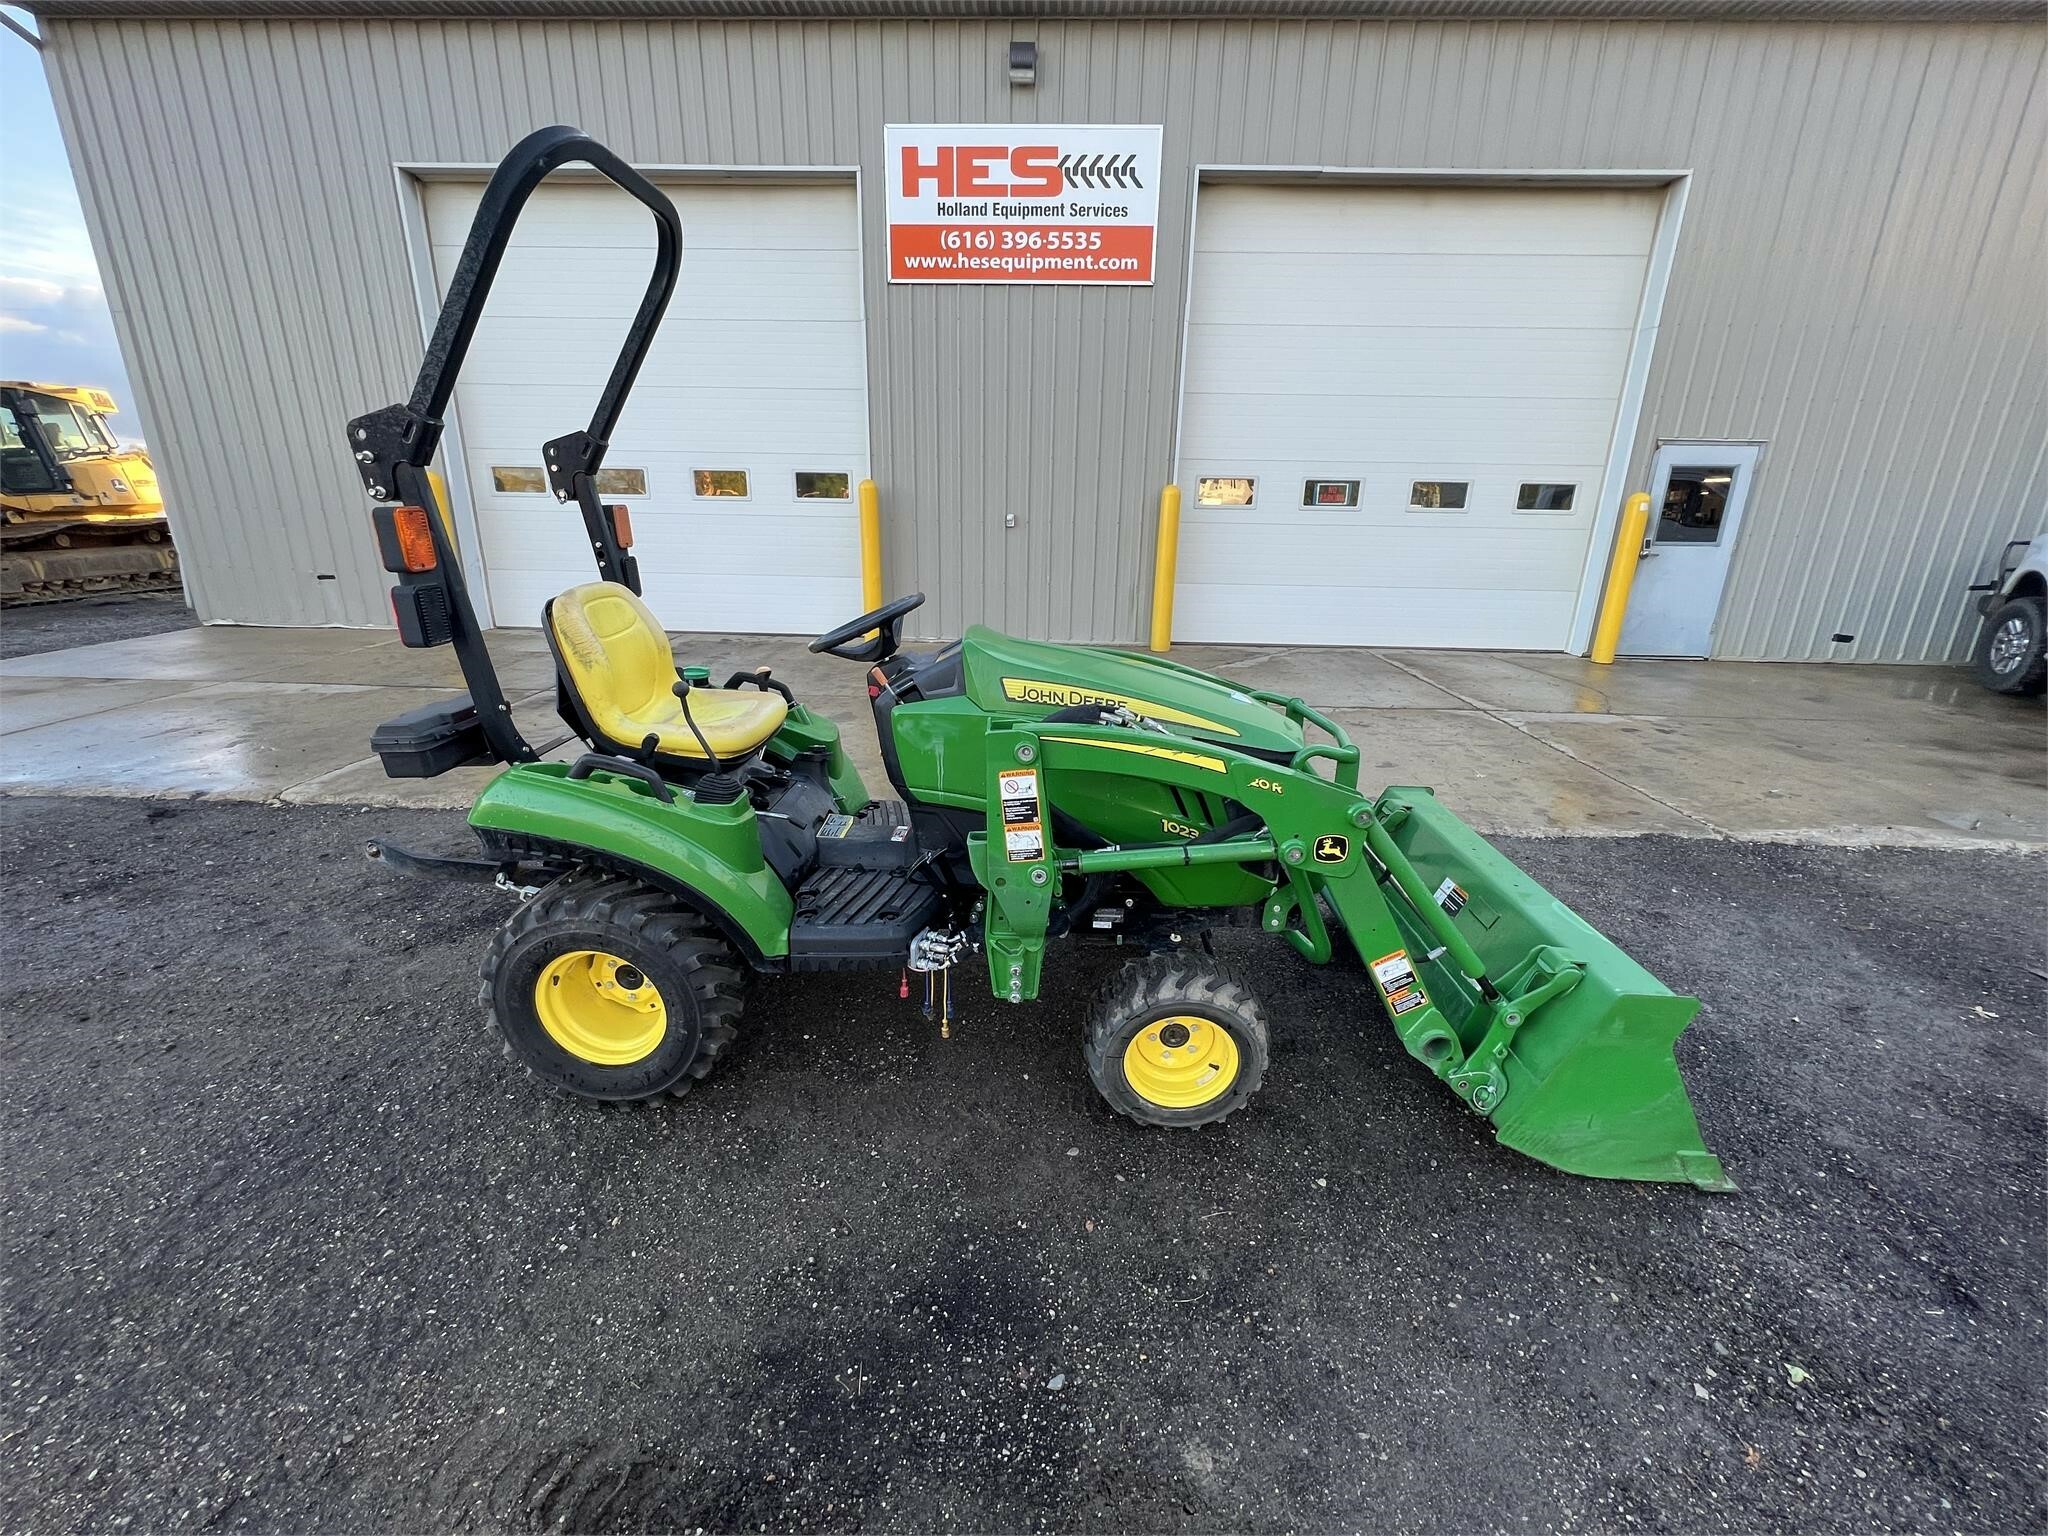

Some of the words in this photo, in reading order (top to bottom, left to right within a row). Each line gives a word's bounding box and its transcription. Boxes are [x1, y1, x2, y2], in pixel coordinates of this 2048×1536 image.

[902, 146, 1063, 197] HES
[937, 202, 988, 217] Holland
[993, 203, 1065, 220] Equipment
[1070, 203, 1128, 218] Services
[940, 230, 995, 250] (616)
[1001, 231, 1101, 250] 396-5535
[904, 253, 1138, 273] www.hesequipment.com
[1017, 686, 1064, 704] JOHN
[1005, 770, 1035, 778] WARNING
[1012, 824, 1040, 832] WARNING
[1161, 818, 1200, 839] 1023
